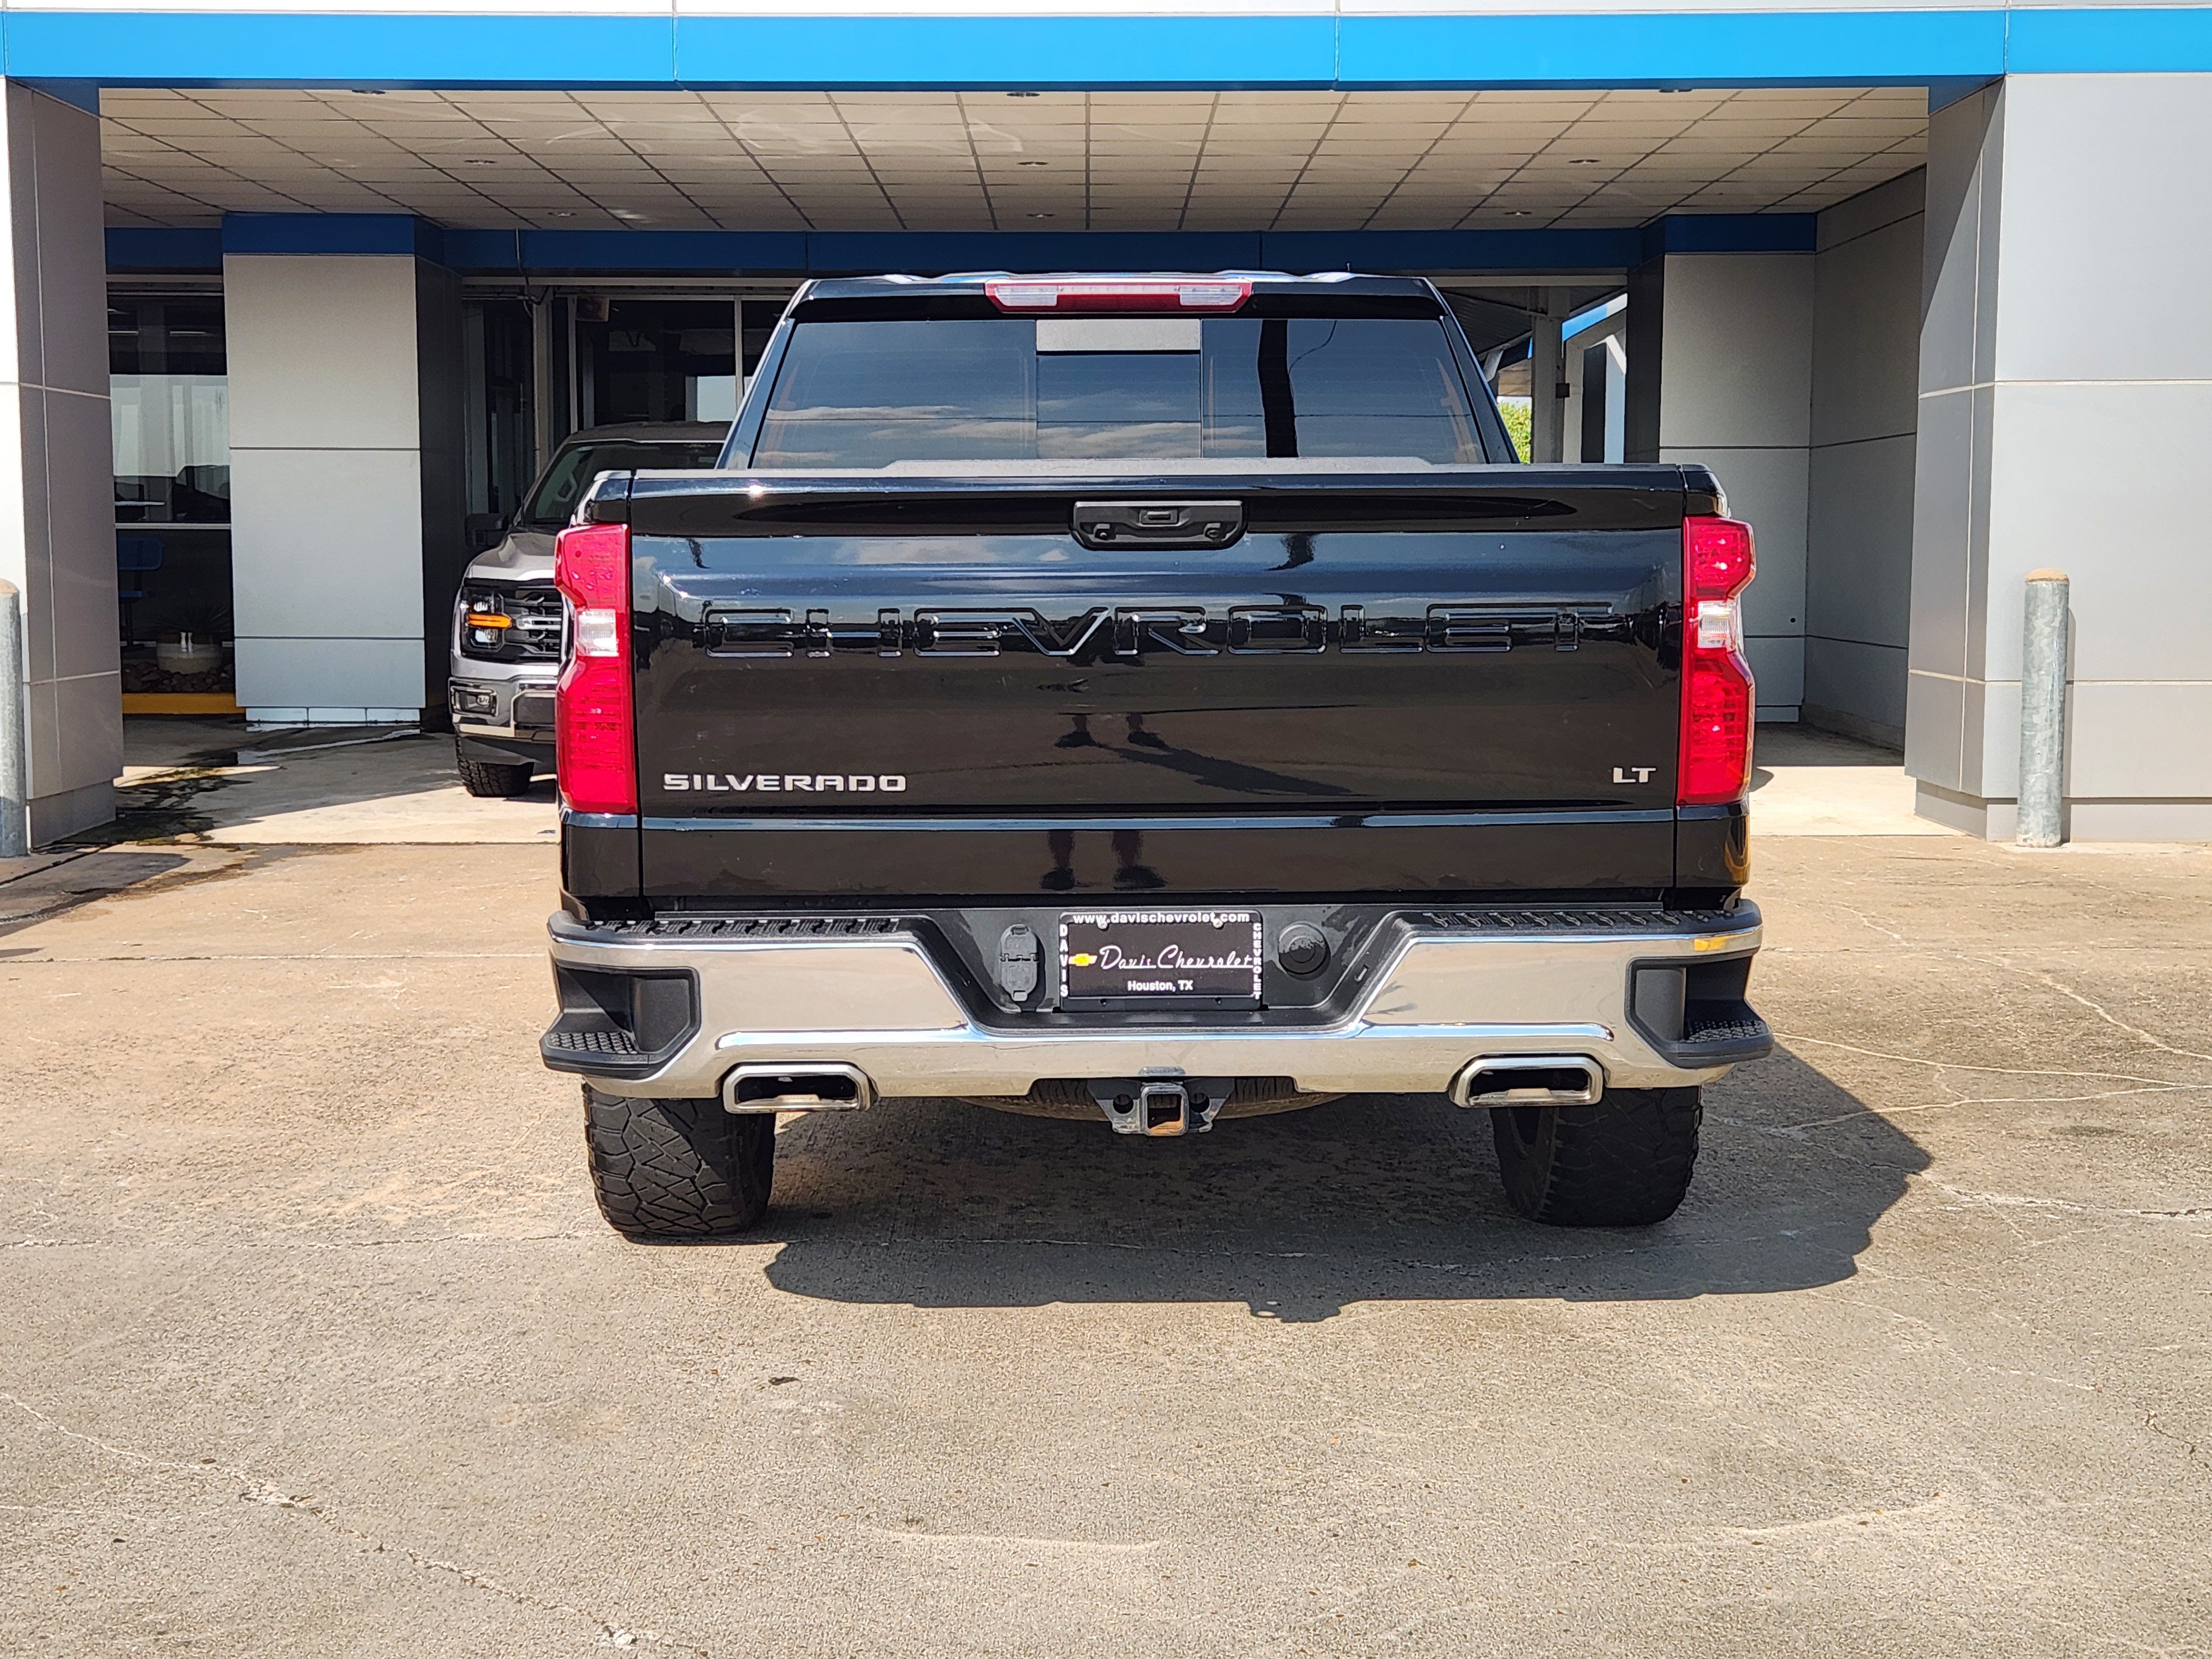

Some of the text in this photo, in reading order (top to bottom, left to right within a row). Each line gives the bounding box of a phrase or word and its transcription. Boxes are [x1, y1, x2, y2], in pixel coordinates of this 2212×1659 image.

[706, 604, 1611, 657] CHEVROLET
[664, 773, 906, 792] SILVERADO
[1612, 766, 1656, 784] LT
[1060, 924, 1068, 997] DAVIS
[1099, 944, 1253, 969] Davis Chevrolet
[1253, 922, 1262, 1000] CHEVROLET
[1127, 980, 1193, 992] Houston, TX
